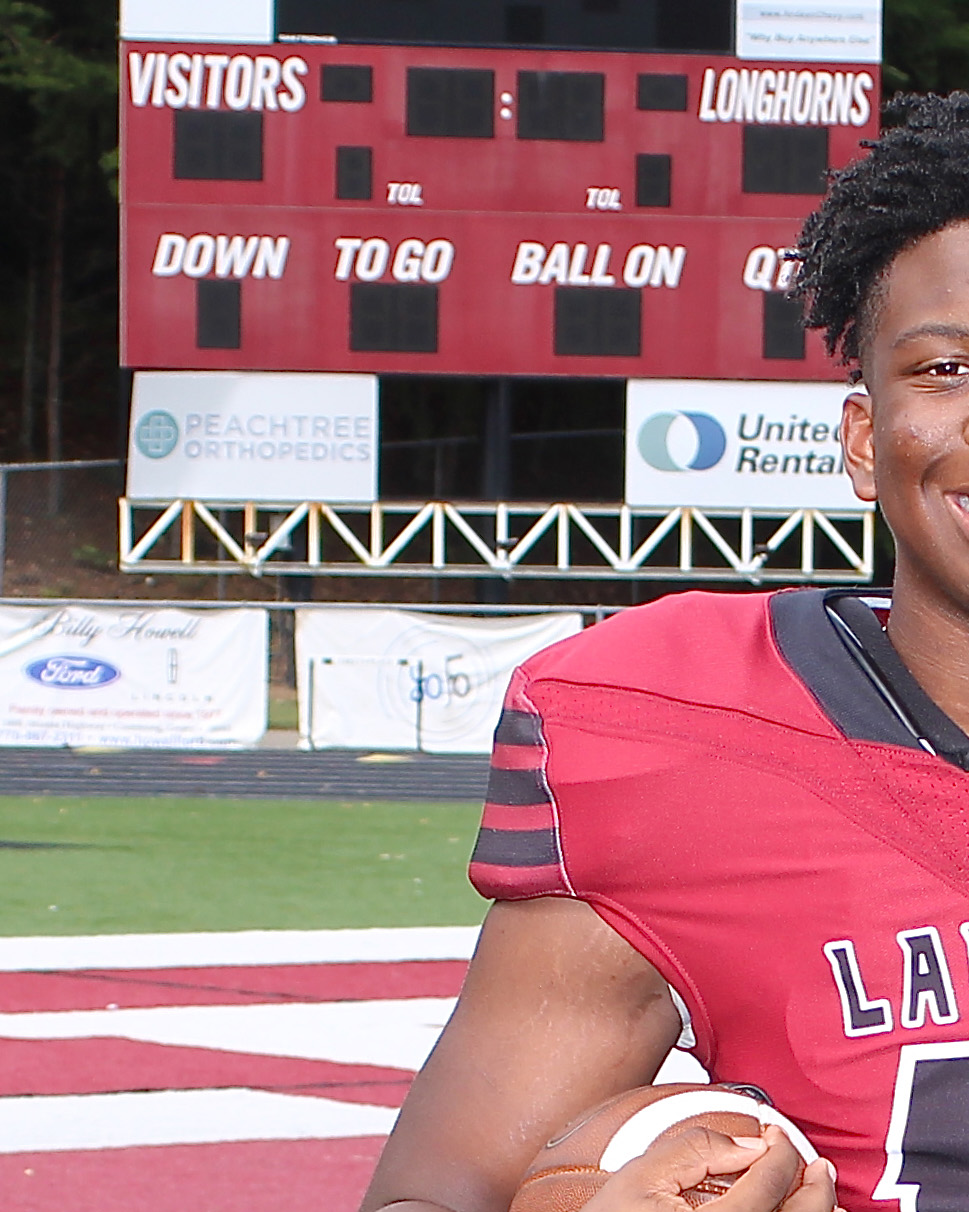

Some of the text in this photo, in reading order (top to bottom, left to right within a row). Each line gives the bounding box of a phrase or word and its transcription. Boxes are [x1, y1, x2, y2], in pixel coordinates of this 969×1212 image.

[128, 52, 308, 112] VISITORS
[699, 68, 873, 126] LONGHORNS
[387, 182, 423, 206] TOL
[585, 187, 623, 210] TOL
[152, 233, 290, 279] DOWN
[335, 238, 455, 282] TO GO
[511, 241, 687, 288] BALL ON
[743, 245, 804, 291] QT
[185, 413, 371, 438] PEACHTREE
[184, 440, 371, 461] ORTHOPEDICS
[46, 608, 203, 647] Billy Howell
[41, 657, 102, 684] Ford
